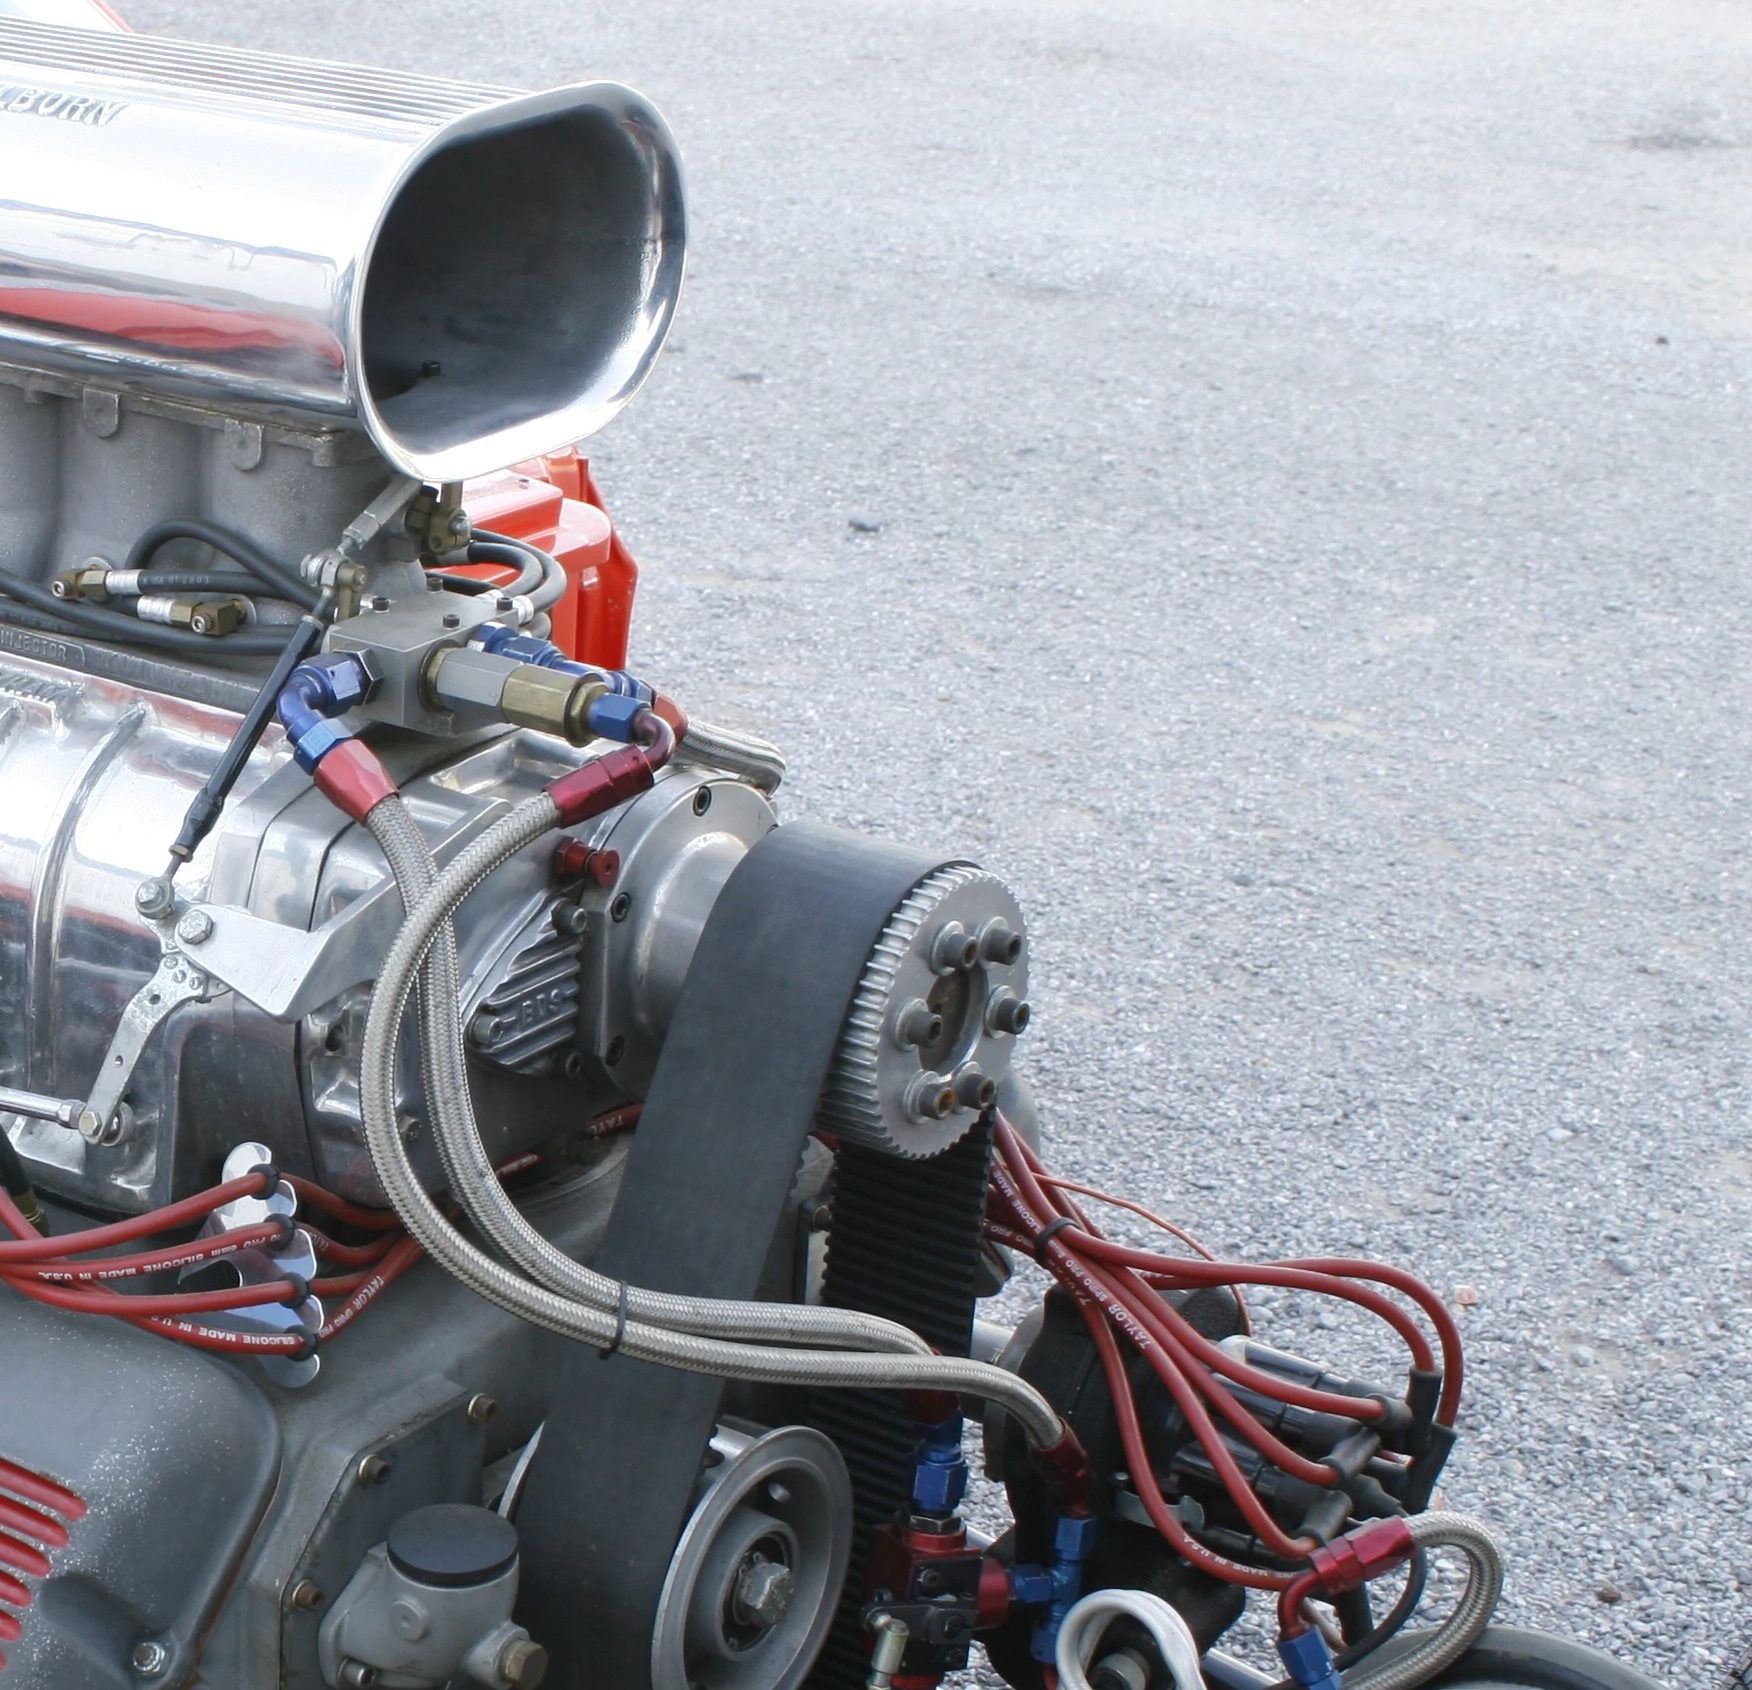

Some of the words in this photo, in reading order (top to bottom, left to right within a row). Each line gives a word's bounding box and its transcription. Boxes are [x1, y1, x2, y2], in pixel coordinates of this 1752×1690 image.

[0, 628, 68, 661] INJECTOR
[142, 1252, 204, 1274] SILICONE
[1065, 1259, 1085, 1278] PRO
[78, 1271, 92, 1281] IN
[98, 1266, 137, 1280] MADE
[353, 1275, 385, 1310] TAYLOR
[178, 1321, 193, 1332] IN
[199, 1326, 236, 1342] MADE
[1108, 1303, 1152, 1350] TAYLOR
[242, 1333, 296, 1345] SILICONE
[1232, 1563, 1268, 1577] MADE
